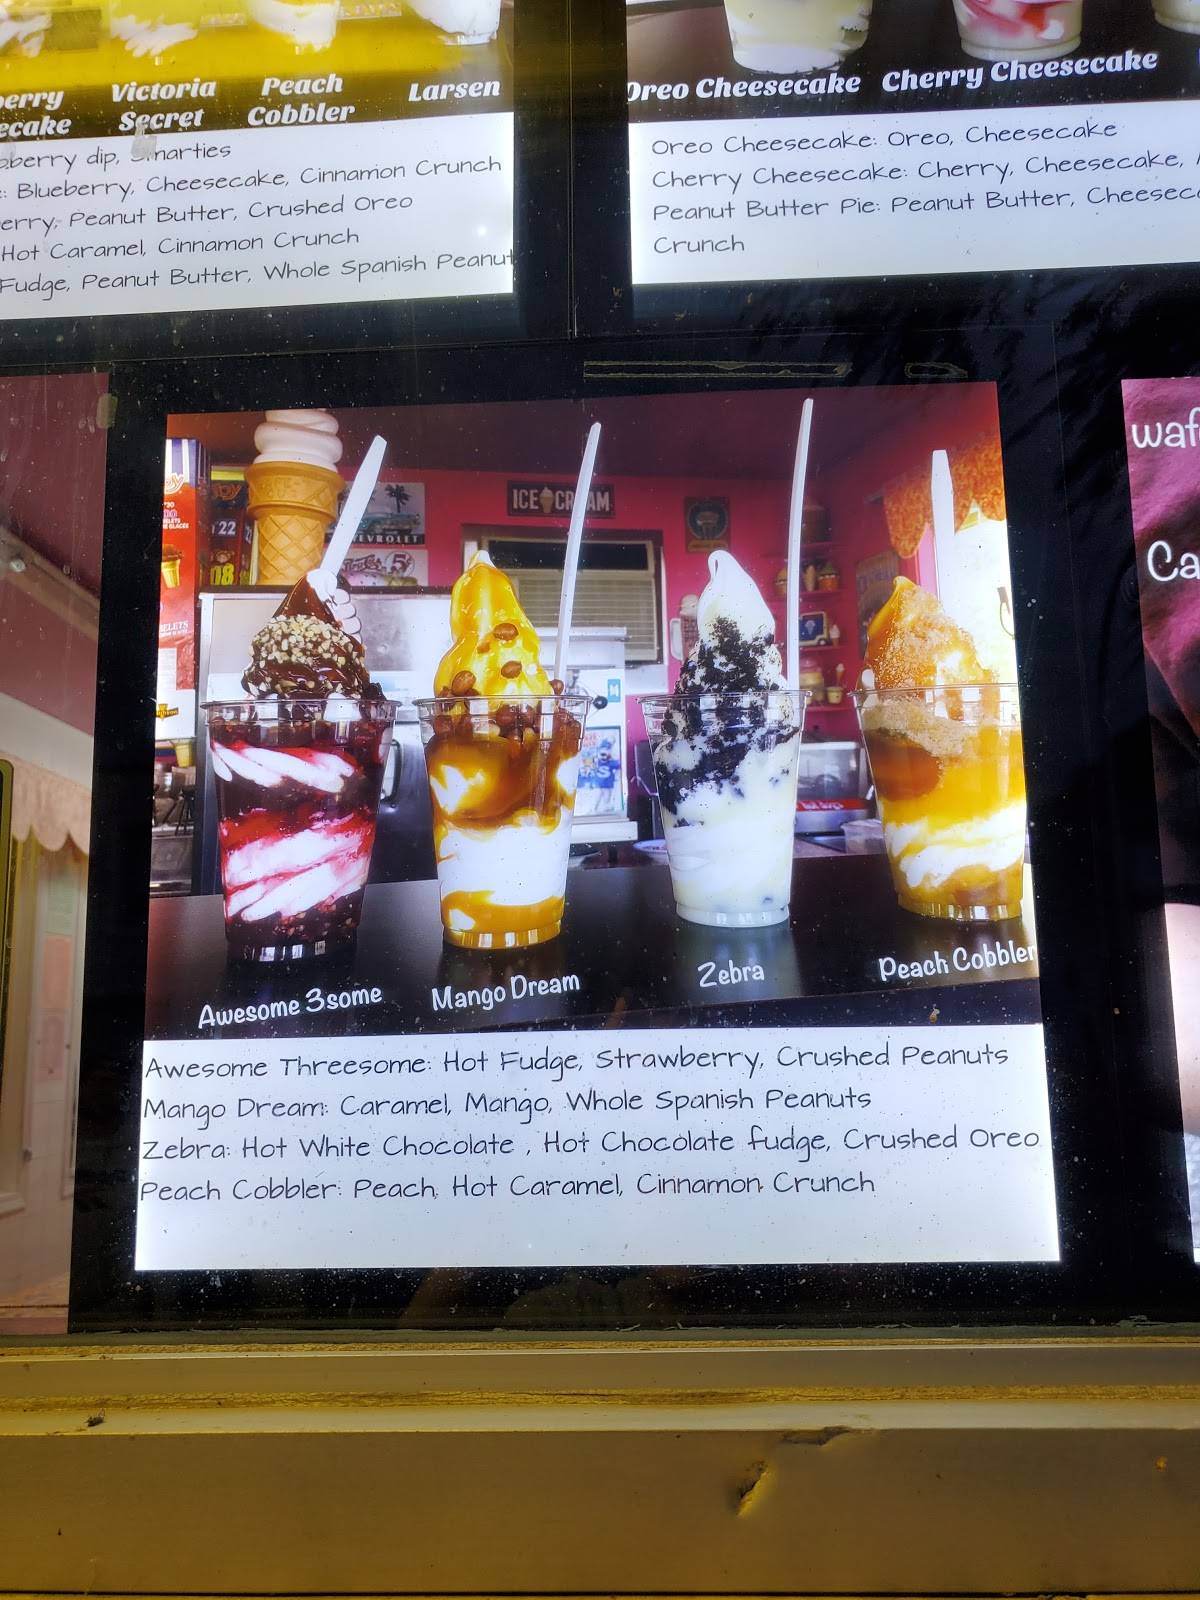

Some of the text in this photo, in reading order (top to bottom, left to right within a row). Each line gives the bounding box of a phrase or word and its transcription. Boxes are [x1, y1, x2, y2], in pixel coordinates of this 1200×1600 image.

[261, 73, 343, 97] Peach
[882, 50, 1159, 92] Cherry Cheesecake
[0, 90, 65, 111] erry
[111, 78, 216, 102] Victoria
[408, 80, 500, 102] Larsen
[626, 73, 861, 102] Oreo Cheesecake
[118, 108, 204, 132] Secret
[247, 103, 355, 127] Cobbler
[652, 120, 1118, 155] Oreo Cheesecake: Oreo, Cheesecake
[86, 146, 120, 171] dip,
[652, 170, 742, 194] Cherry
[753, 162, 908, 184] Cheesecake:
[918, 160, 1014, 184] Cherry,
[1025, 150, 1183, 173] Cheesecake,
[17, 180, 134, 202] Blueberry,
[146, 169, 289, 193] Cheesecake,
[300, 163, 405, 184] Cinnamon
[415, 155, 501, 176] Crunch
[69, 208, 146, 228] Peanut
[156, 205, 238, 223] Butter,
[248, 194, 344, 218] Crushed
[354, 196, 413, 212] Oreo
[653, 201, 735, 220] Peanut
[746, 199, 829, 217] Butter
[840, 197, 880, 214] Pie:
[891, 192, 975, 213] Peanut
[986, 190, 1074, 209] Butter,
[1, 228, 359, 262] Hot Caramel, Cinnamon Crunch
[653, 234, 745, 254] Crunch
[0, 273, 70, 301] Fudge,
[82, 269, 160, 290] Peanut
[170, 266, 251, 285] Butter,
[264, 260, 330, 280] Whole
[340, 254, 426, 283] Spanish
[513, 488, 610, 512] ICE CRAM
[353, 534, 418, 543] EVROLET
[697, 961, 765, 989] Zebra
[878, 940, 1038, 981] Peach Cobbler
[432, 973, 580, 1011] Mango Dream
[197, 986, 382, 1029] Awesome 3some
[145, 1041, 1008, 1082] Awesome Threesome: Hot Fudge, Strawberry, Crushed Peanuts
[144, 1087, 872, 1130] Mango Dream: Caramel, Mango, Whole Spanish Peanuts
[142, 1137, 230, 1160] Zebra:
[243, 1137, 287, 1159] Hot
[299, 1134, 370, 1157] White
[383, 1134, 514, 1156] Chocolate
[544, 1131, 589, 1153] Hot
[601, 1130, 735, 1153] Chocolate
[748, 1125, 830, 1162] fudge,
[843, 1124, 957, 1149] Crushed
[969, 1128, 1040, 1148] Oreo
[140, 1180, 221, 1201] Peach
[233, 1178, 341, 1199] Cobbler:
[453, 1175, 498, 1197] Hot
[510, 1174, 623, 1197] Caramel,
[637, 1173, 761, 1194] Cinnamon
[773, 1171, 875, 1192] Crunch
